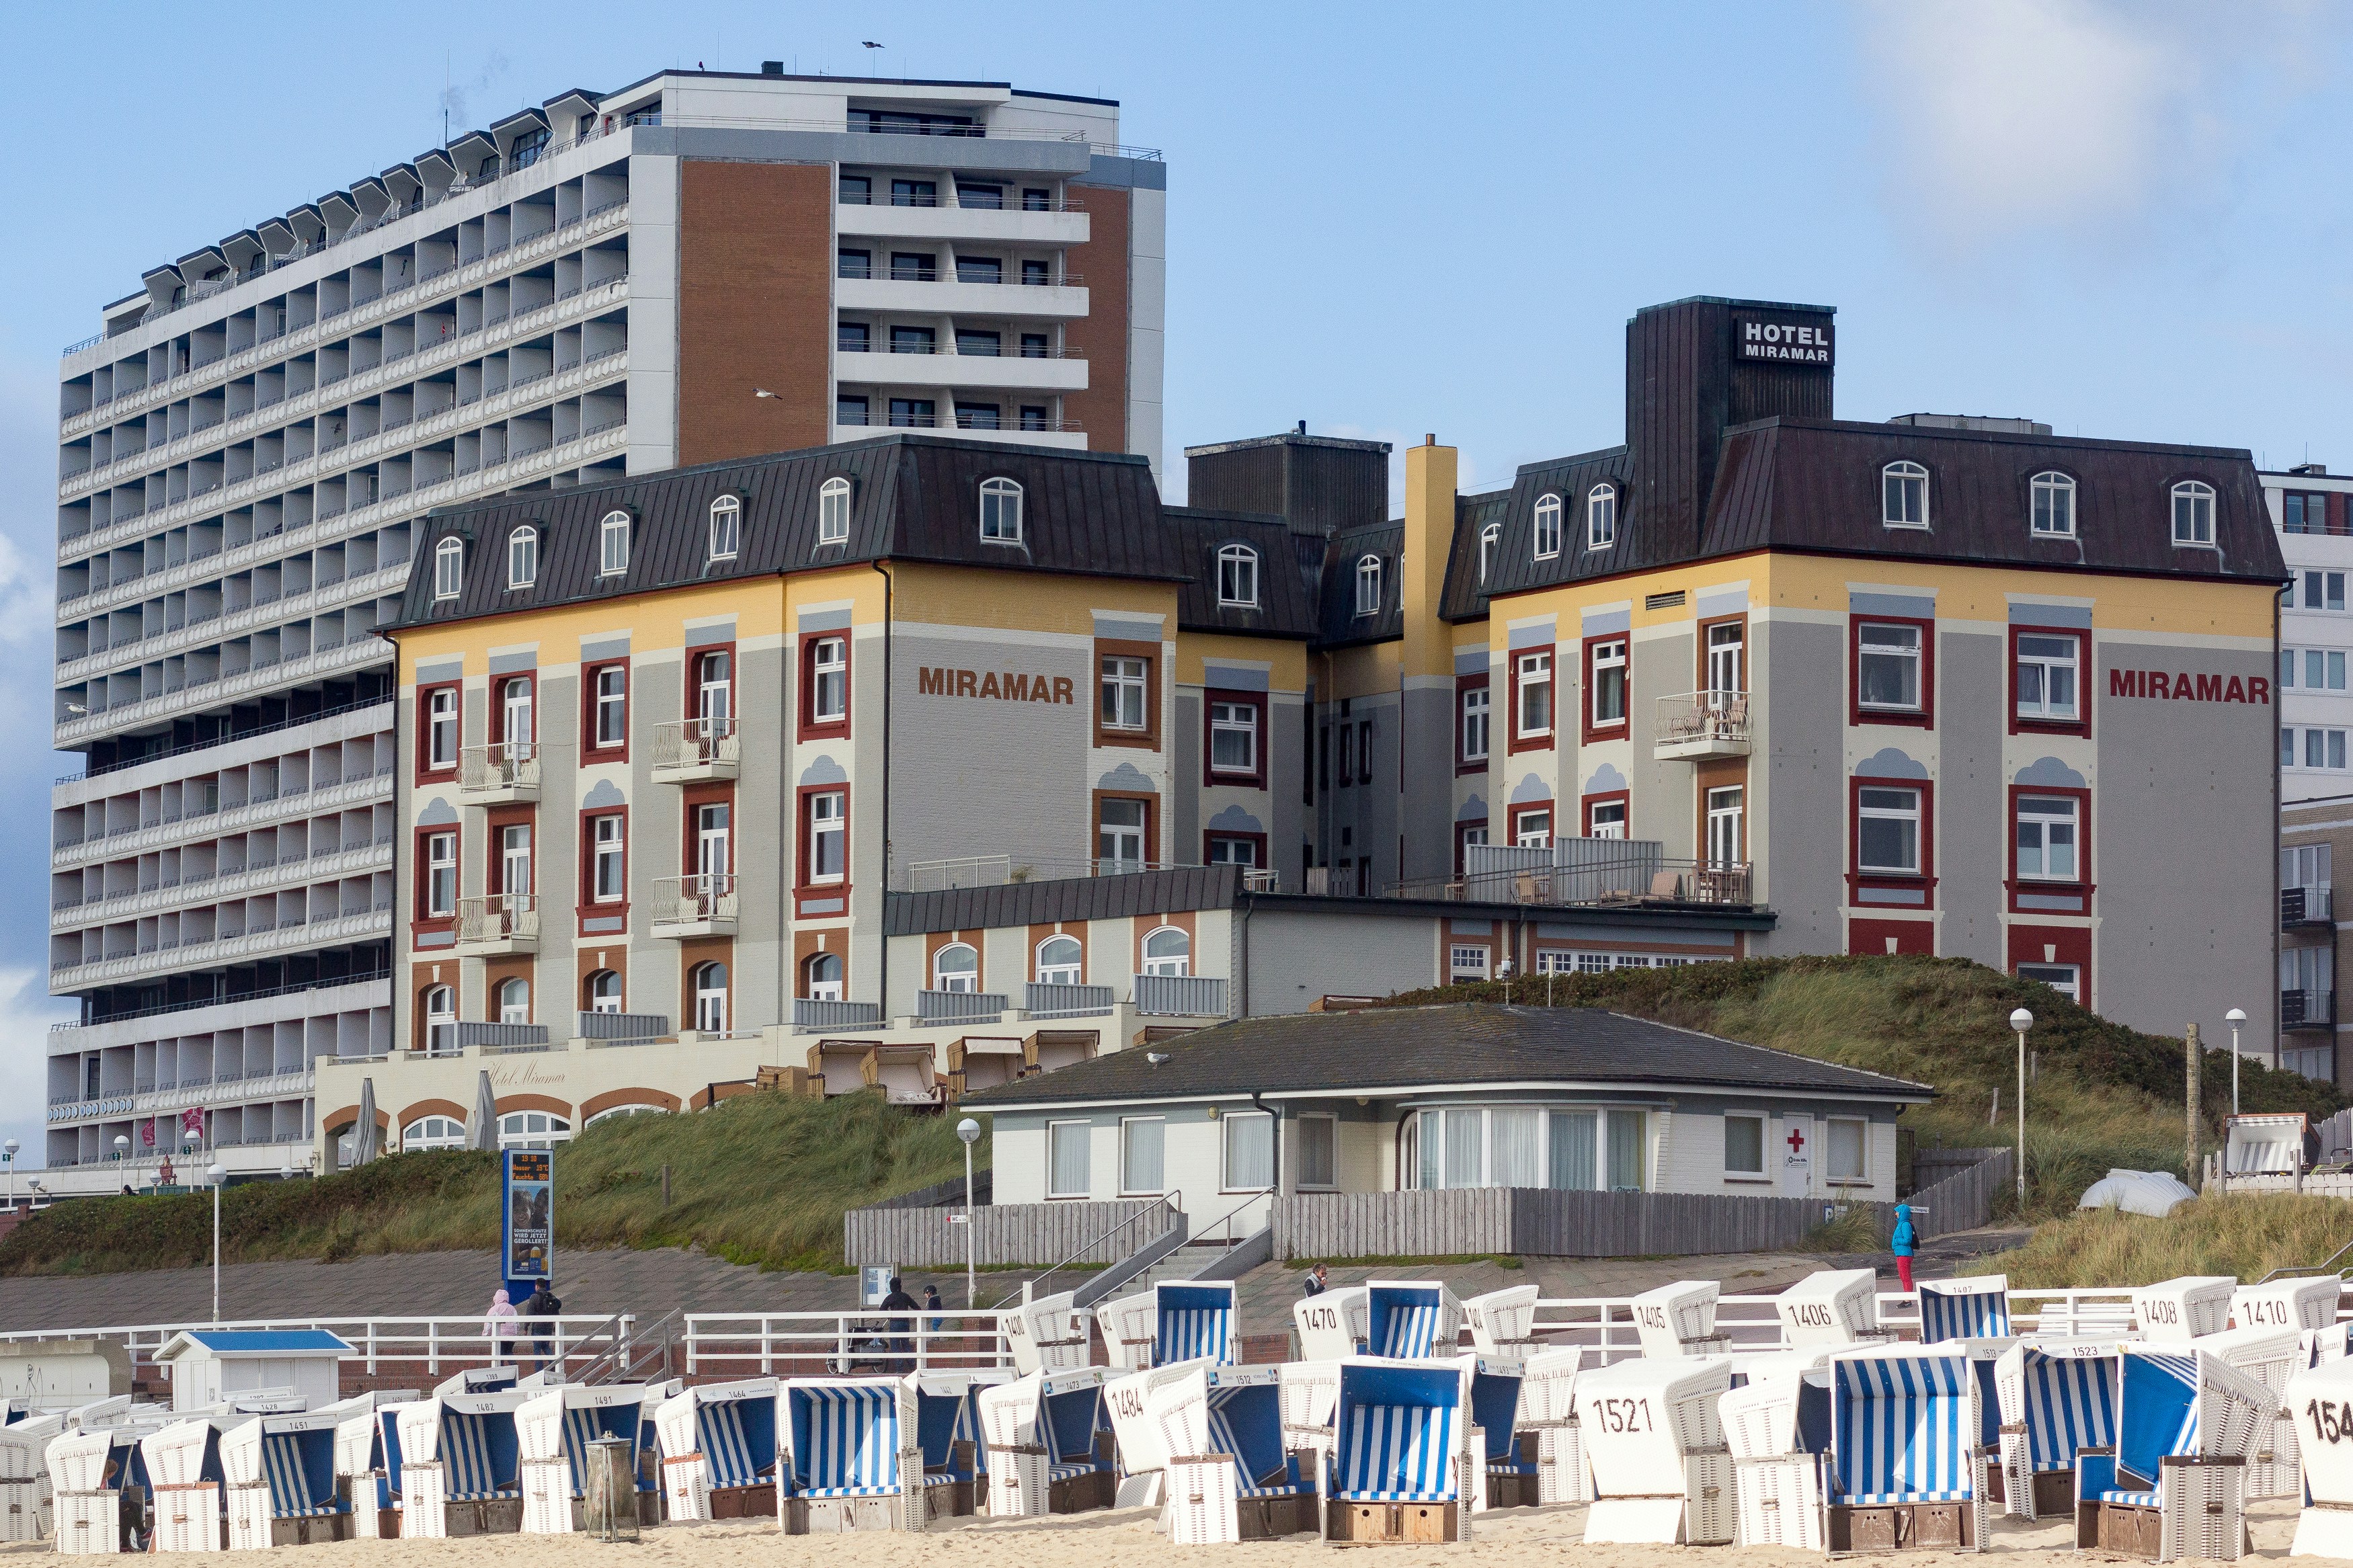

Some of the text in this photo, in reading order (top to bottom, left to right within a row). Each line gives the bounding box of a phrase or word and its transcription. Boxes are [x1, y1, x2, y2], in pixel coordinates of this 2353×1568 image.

[1745, 323, 1829, 346] HOTEL
[1745, 344, 1829, 361] MIRAMAR
[918, 667, 1074, 705] MIRAMAR
[2110, 669, 2270, 704] MIRAMAR
[488, 1059, 565, 1087] Hotel Miramar
[48, 1108, 76, 1119] HOTEL
[81, 1104, 98, 1115] MON
[1953, 1286, 1972, 1294] 1407
[1302, 1307, 1337, 1331] 1470
[1637, 1305, 1666, 1329] 1405
[1788, 1303, 1832, 1327] 1406
[2141, 1300, 2178, 1325] 1408
[2242, 1300, 2287, 1325] 1410
[1005, 1315, 1025, 1338] 1400
[1983, 1349, 1997, 1358] 1513
[2072, 1346, 2098, 1357] 1523
[1236, 1375, 1252, 1385] 1512
[1496, 1366, 1509, 1376] 1493
[728, 1389, 746, 1398] 1464
[1066, 1380, 1080, 1391] 1473
[475, 1403, 494, 1412] 1482
[594, 1395, 612, 1405] 1491
[1111, 1387, 1144, 1420] 1484
[289, 1421, 309, 1430] 1451
[1592, 1397, 1653, 1434] 1521
